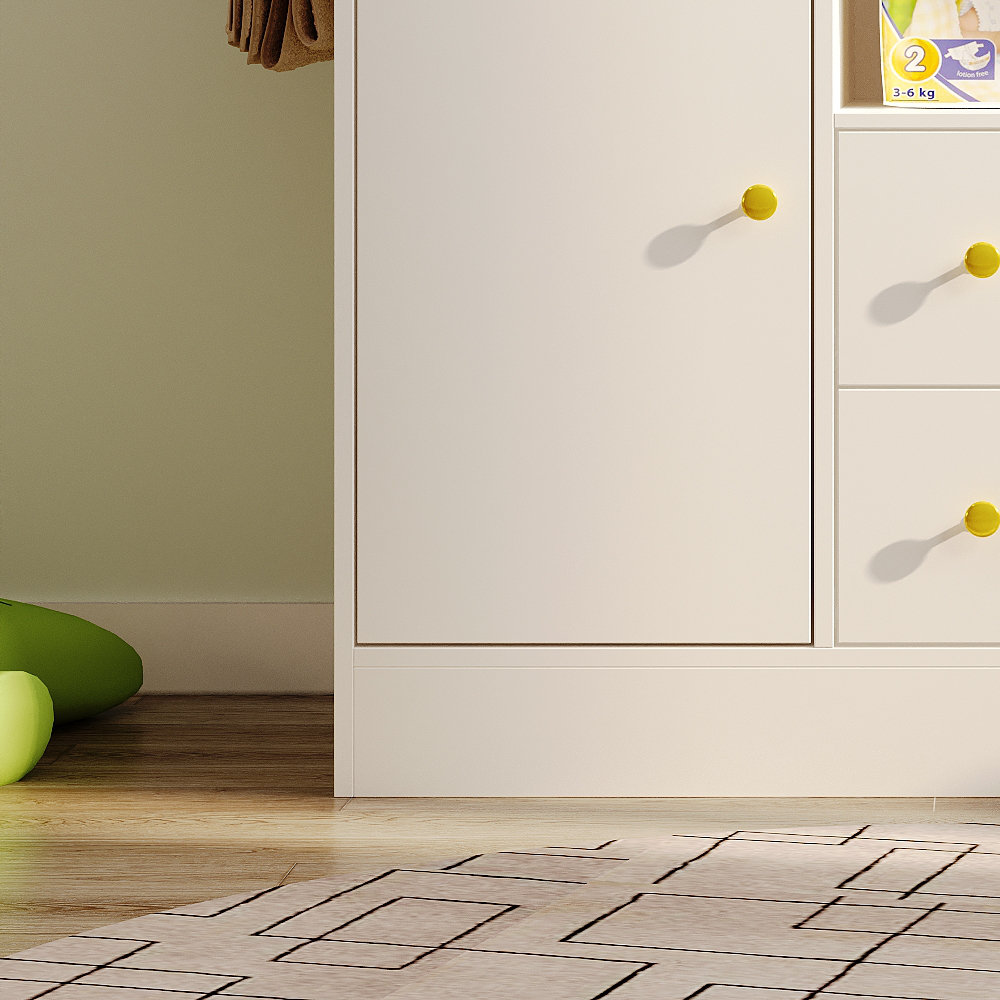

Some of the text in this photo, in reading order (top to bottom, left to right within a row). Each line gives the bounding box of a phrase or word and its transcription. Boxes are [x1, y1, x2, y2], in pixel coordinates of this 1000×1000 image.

[904, 45, 927, 72] 2
[956, 70, 975, 78] lotion
[893, 87, 935, 100] 3-6 kg
